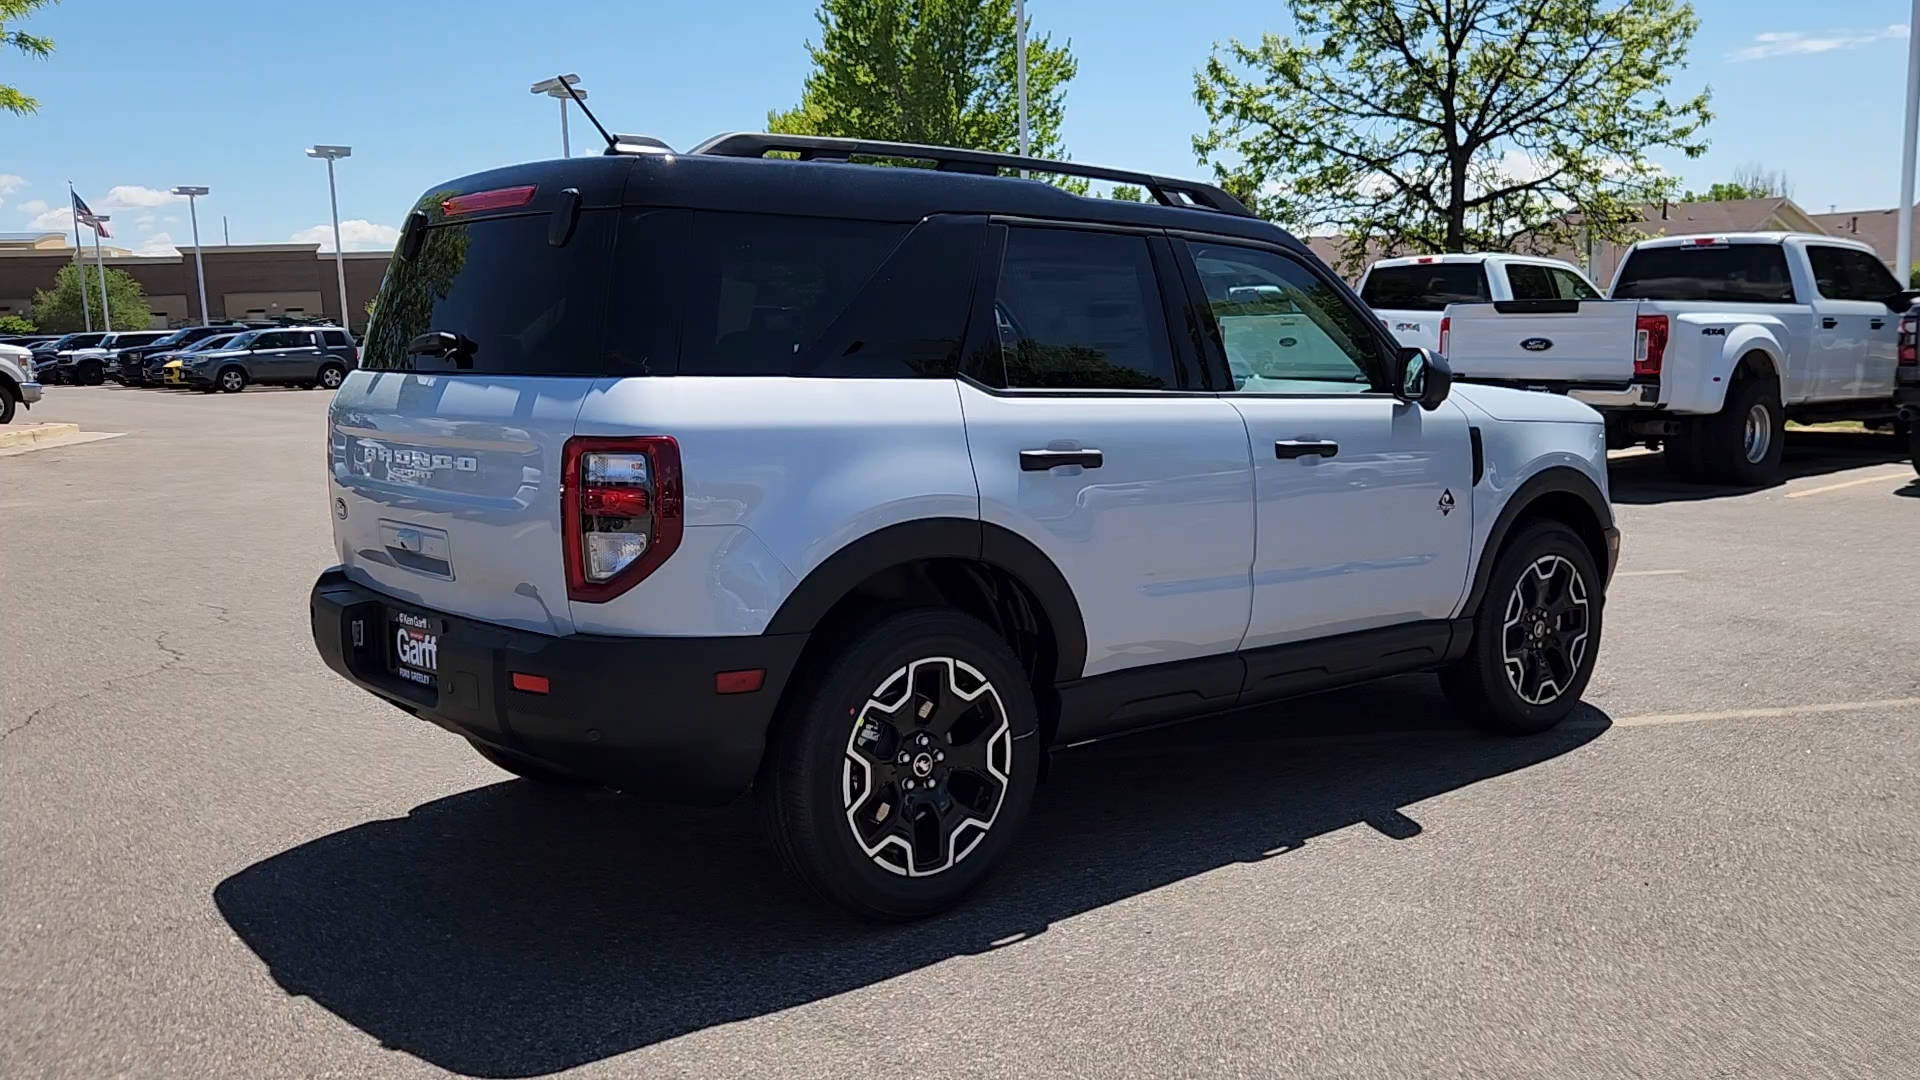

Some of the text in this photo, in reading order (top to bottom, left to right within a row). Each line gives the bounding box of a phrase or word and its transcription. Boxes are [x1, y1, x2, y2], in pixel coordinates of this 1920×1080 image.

[364, 447, 478, 472] BRONCO
[394, 466, 434, 479] SPORT
[397, 628, 437, 670] Garff
